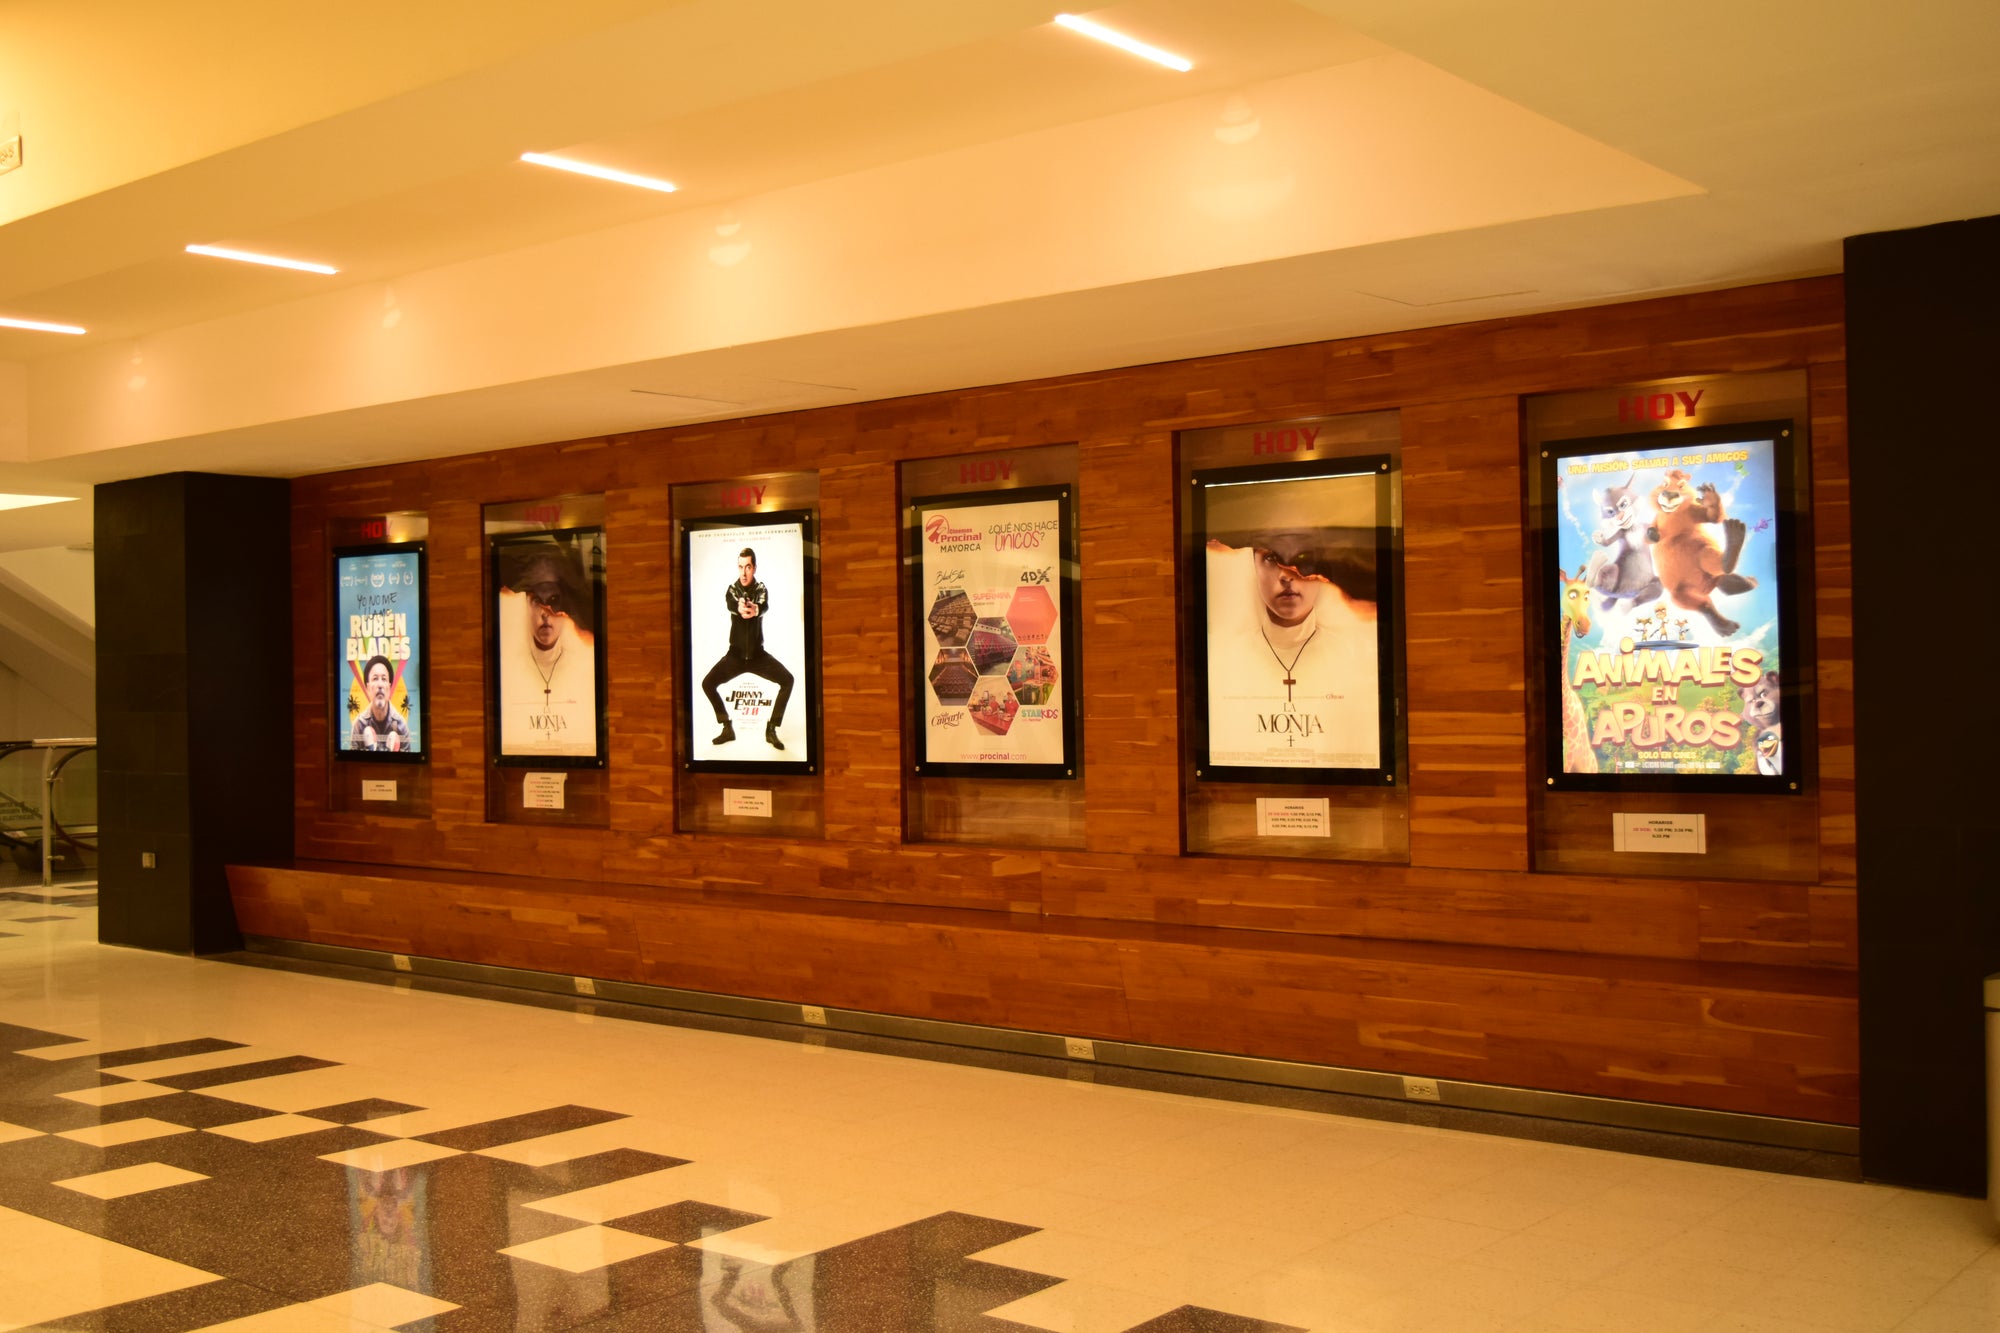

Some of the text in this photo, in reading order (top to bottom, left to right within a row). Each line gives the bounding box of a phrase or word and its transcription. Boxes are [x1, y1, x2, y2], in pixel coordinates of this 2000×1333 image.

[1618, 389, 1704, 423] HOY
[1253, 427, 1321, 455] HOY
[1672, 457, 1679, 466] A
[1681, 454, 1703, 466] SUS
[1705, 451, 1748, 464] AMIGOS
[960, 458, 1015, 485] HOY
[721, 485, 767, 508] HOY
[988, 520, 1058, 535] ¿QUÉ NOS HACE
[941, 532, 982, 543] Procinal
[940, 543, 981, 553] MAYORCA
[357, 592, 398, 610] YO NO ME
[346, 636, 411, 661] BLADES
[1651, 687, 1679, 704] EN
[1283, 703, 1296, 713] LA
[529, 714, 568, 732] MONJA
[1256, 713, 1325, 737] MONJA
[1591, 702, 1741, 750] APUROS
[960, 752, 1027, 761] www.procinal.com
[1637, 751, 1659, 759] SOLO
